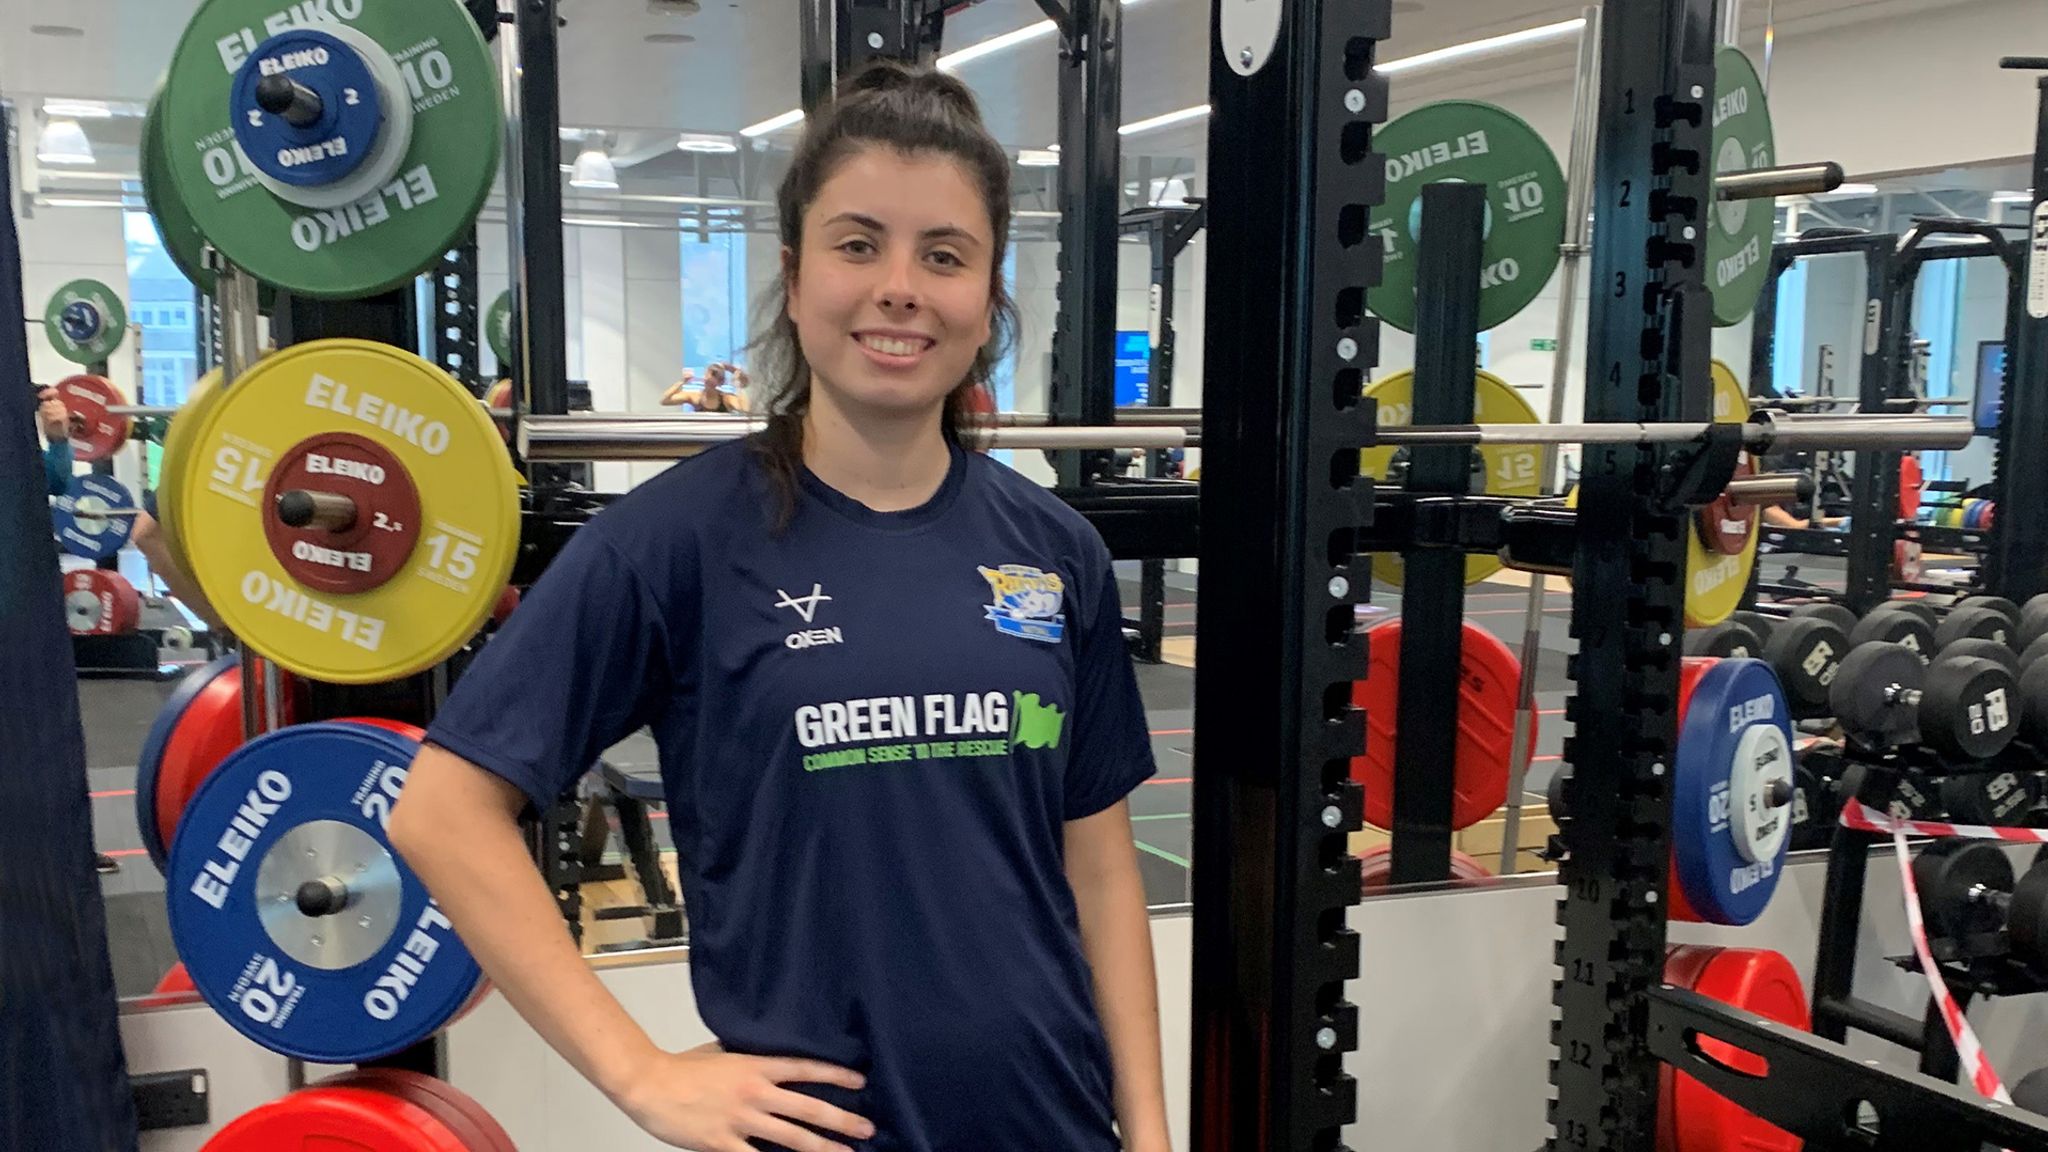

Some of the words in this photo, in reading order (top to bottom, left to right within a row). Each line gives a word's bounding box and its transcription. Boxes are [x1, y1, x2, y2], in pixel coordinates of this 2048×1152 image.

[258, 47, 330, 77] ELEIKO
[401, 50, 453, 99] 10
[247, 109, 264, 128] 2
[344, 87, 361, 106] 2
[411, 85, 461, 115] WEDEN
[1623, 88, 1635, 115] 1
[1712, 86, 1748, 128] LEIKO
[277, 137, 348, 167] ELEIKO
[290, 164, 439, 252] ELEIKO
[1619, 180, 1631, 208] 2
[1717, 235, 1760, 287] ELEIKO
[1614, 271, 1627, 298] 3
[1610, 361, 1621, 388] 4
[304, 373, 450, 455] ELEIKO
[212, 446, 265, 493] 15
[305, 453, 386, 486] ELEIKO
[292, 540, 373, 573] ELEIKO
[425, 533, 481, 580] 15
[240, 570, 386, 651] ELEIKO
[794, 696, 918, 748] GREEN
[924, 691, 1009, 736] FLAG
[190, 770, 293, 910] ELEIKO
[226, 952, 266, 1004] SWEDEN
[363, 896, 454, 1021] LEIKO
[240, 957, 296, 1024] 20
